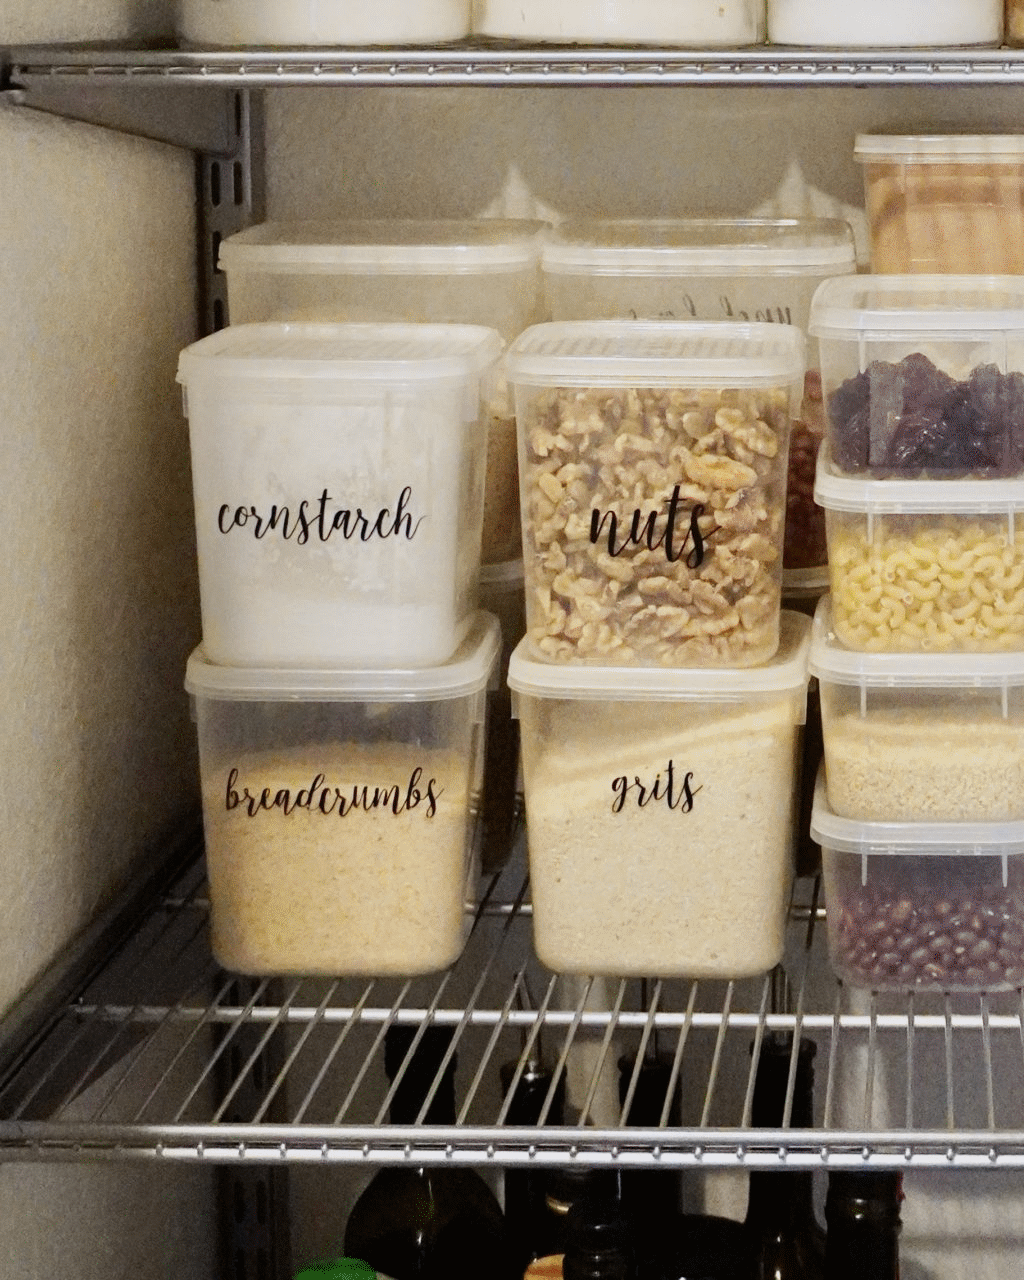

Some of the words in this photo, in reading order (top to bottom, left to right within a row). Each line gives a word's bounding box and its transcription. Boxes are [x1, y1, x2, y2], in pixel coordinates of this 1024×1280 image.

[217, 486, 428, 545] cornstarch
[590, 484, 722, 570] nuts
[226, 767, 444, 818] breadcrumbs
[611, 759, 703, 813] grits
